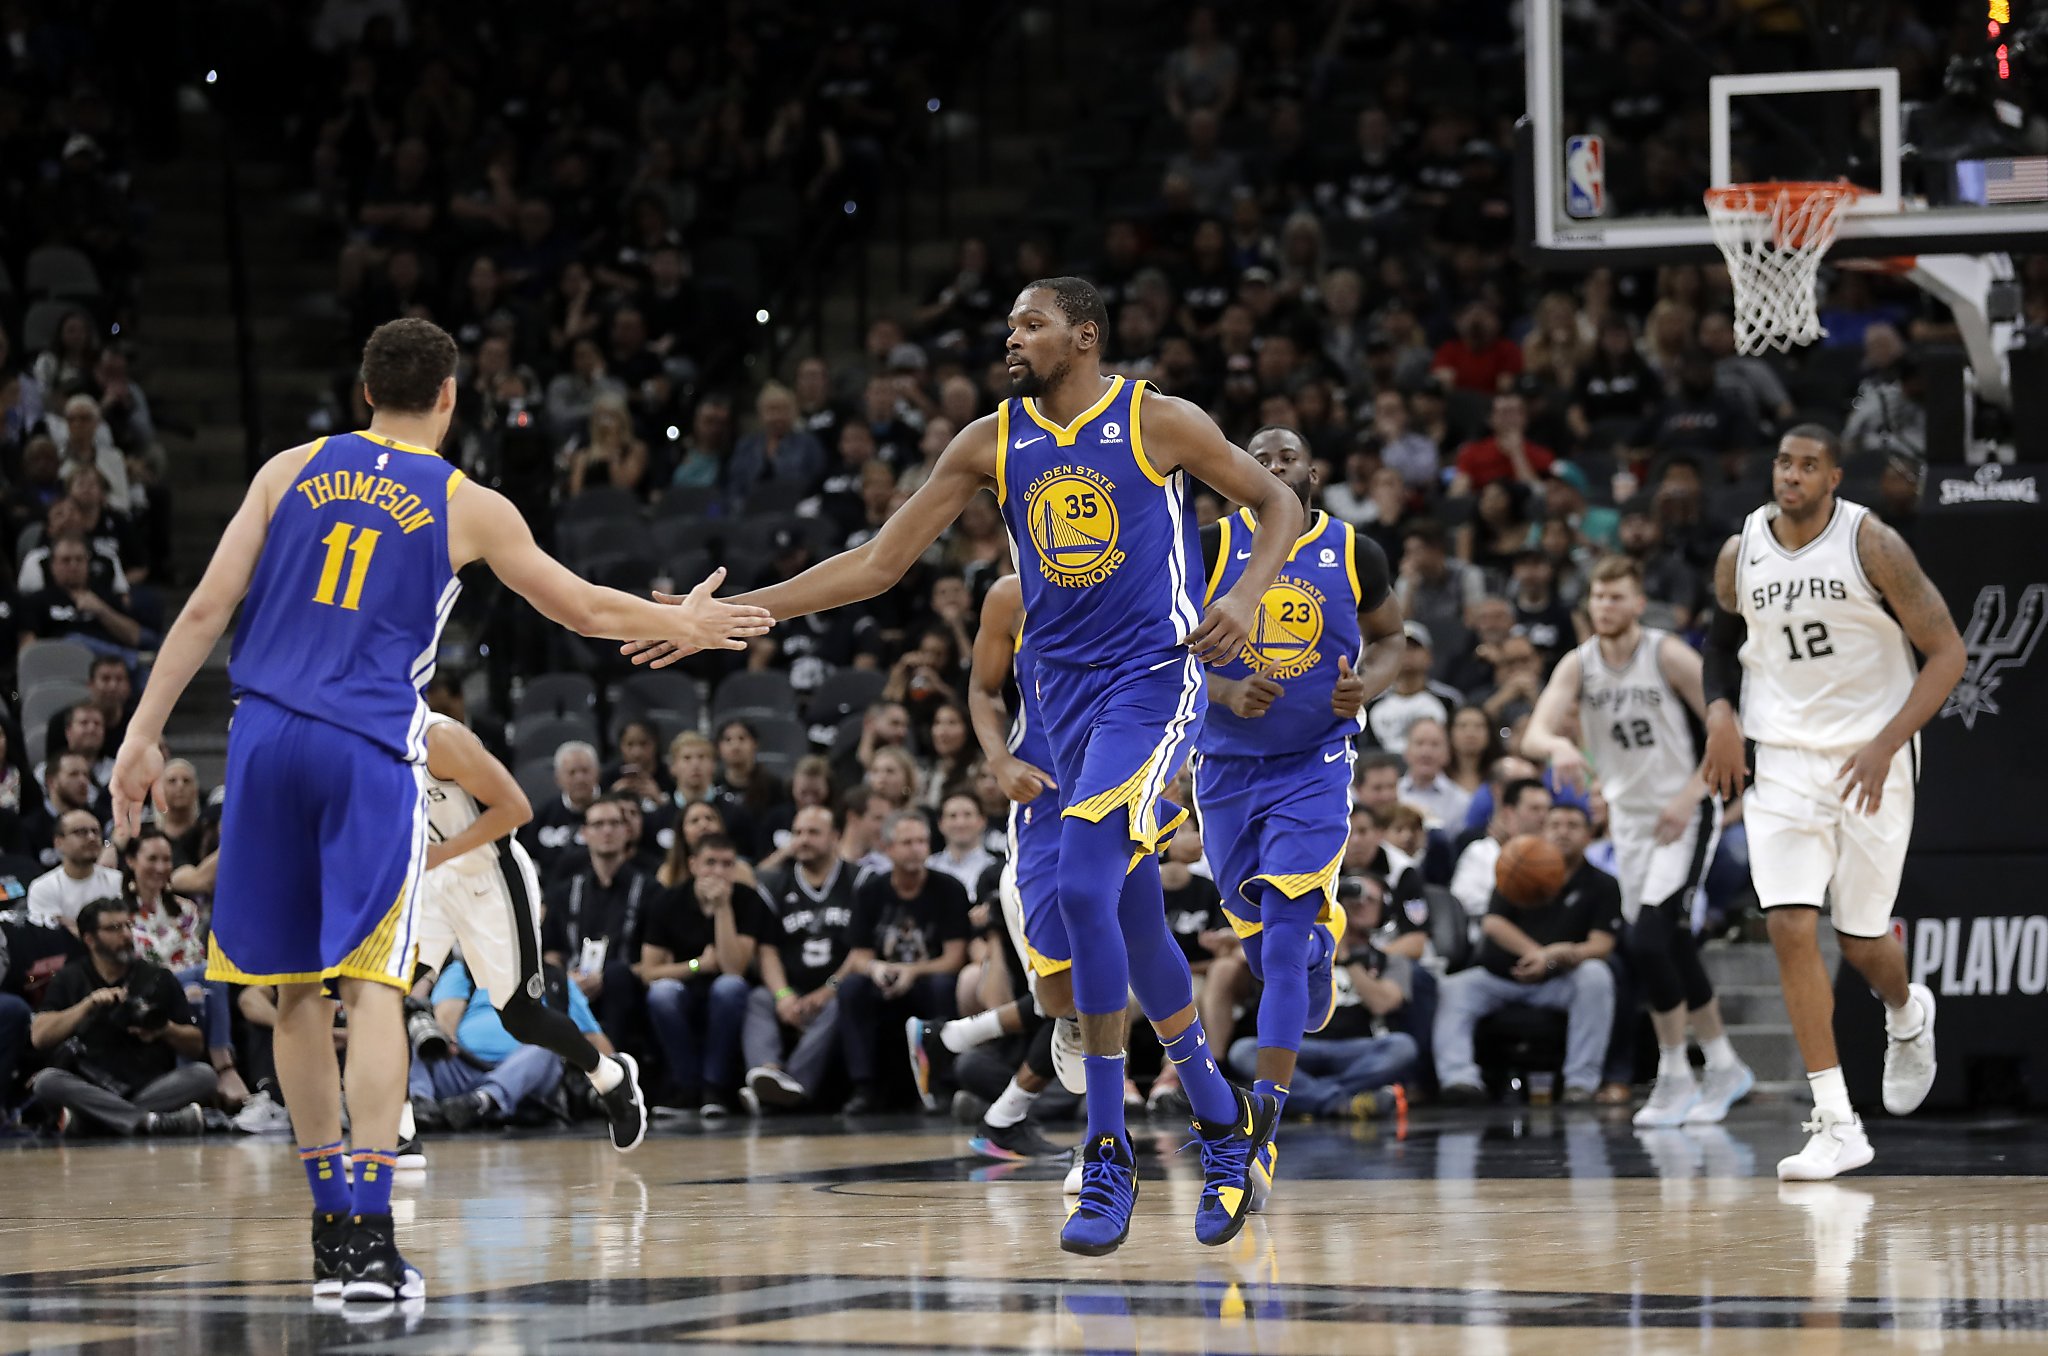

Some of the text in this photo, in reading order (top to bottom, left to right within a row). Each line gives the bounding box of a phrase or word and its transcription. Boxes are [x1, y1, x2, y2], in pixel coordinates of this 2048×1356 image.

[1023, 464, 1117, 502] GOLDEN STATE
[296, 470, 435, 534] THOMPSON
[1064, 492, 1098, 520] 35
[312, 521, 383, 611] 11
[1038, 548, 1126, 589] WARRIORS
[1293, 577, 1327, 605] STATE
[1752, 577, 1847, 611] SPURS
[1280, 601, 1311, 623] 23
[1783, 621, 1834, 661] 12
[1238, 649, 1322, 680] WARIORS
[1611, 718, 1656, 750] 42
[1911, 914, 2048, 996] PLAYO
